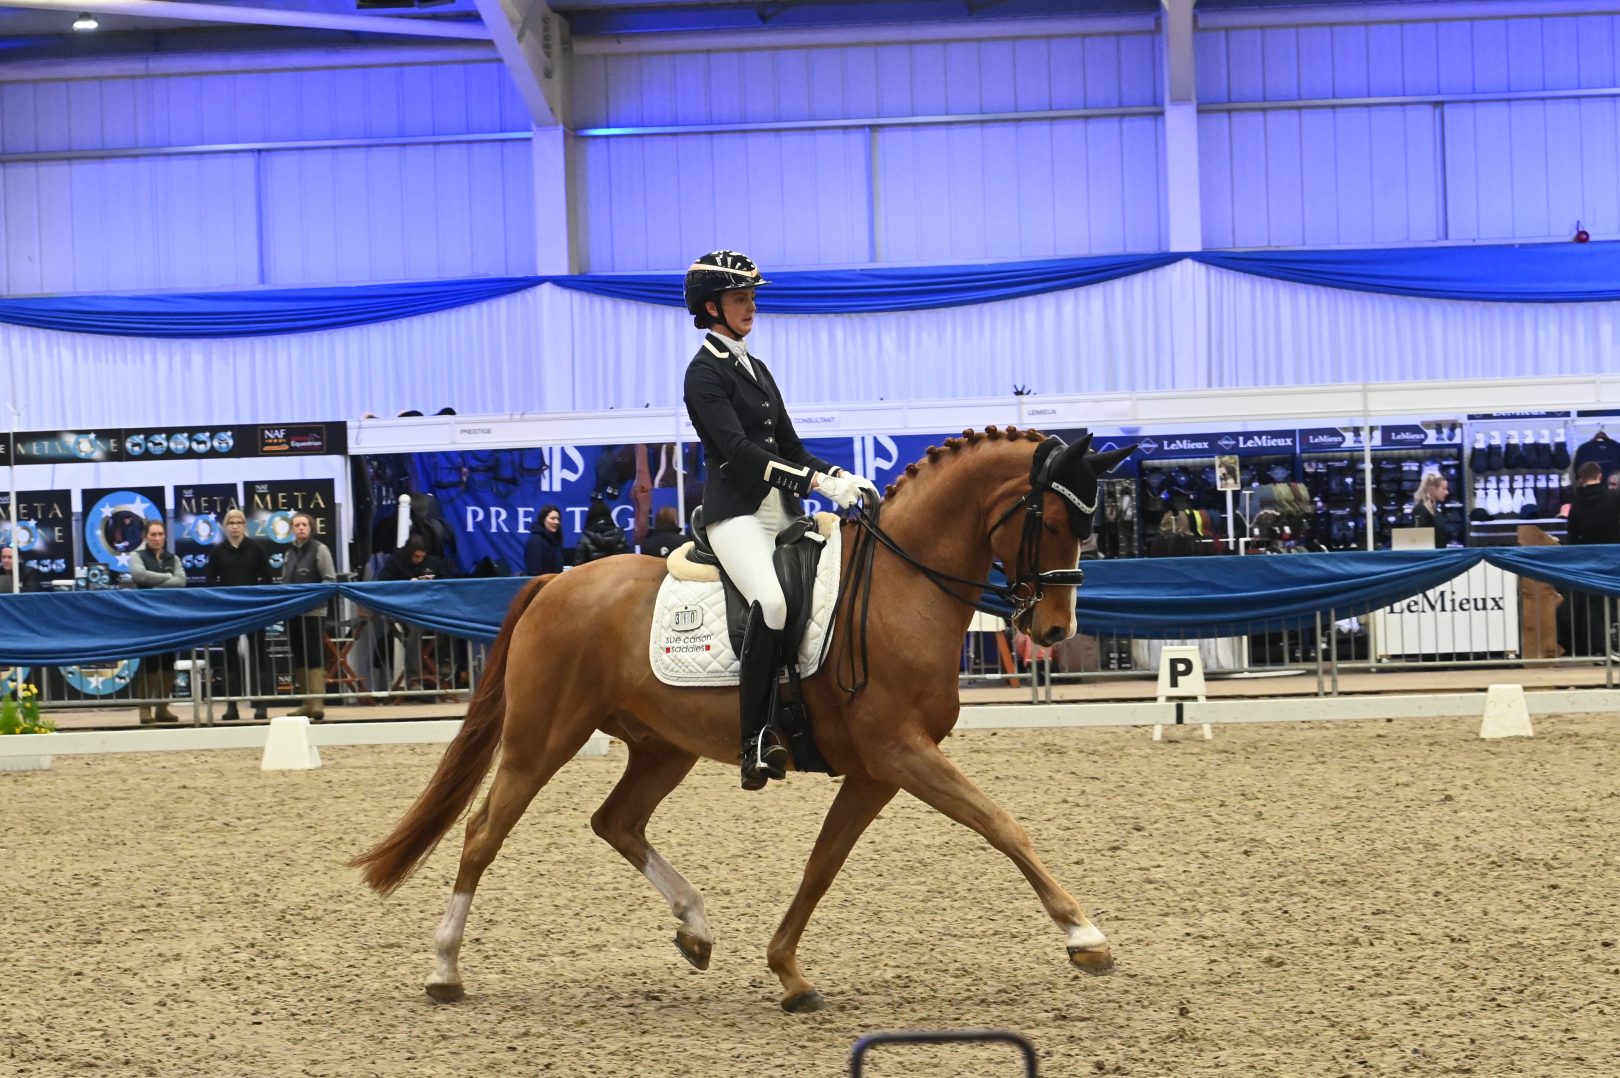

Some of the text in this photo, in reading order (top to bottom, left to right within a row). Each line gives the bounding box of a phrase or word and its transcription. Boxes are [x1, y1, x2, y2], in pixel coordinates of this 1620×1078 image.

[264, 429, 287, 439] NAF
[1391, 432, 1425, 440] LeMieux
[1238, 435, 1293, 448] LeMieux
[1309, 435, 1343, 444] LeMieux
[1163, 440, 1209, 450] LeMieux
[253, 491, 326, 510] META
[683, 634, 712, 644] carson
[671, 645, 705, 653] saddles
[1169, 657, 1194, 688] P
